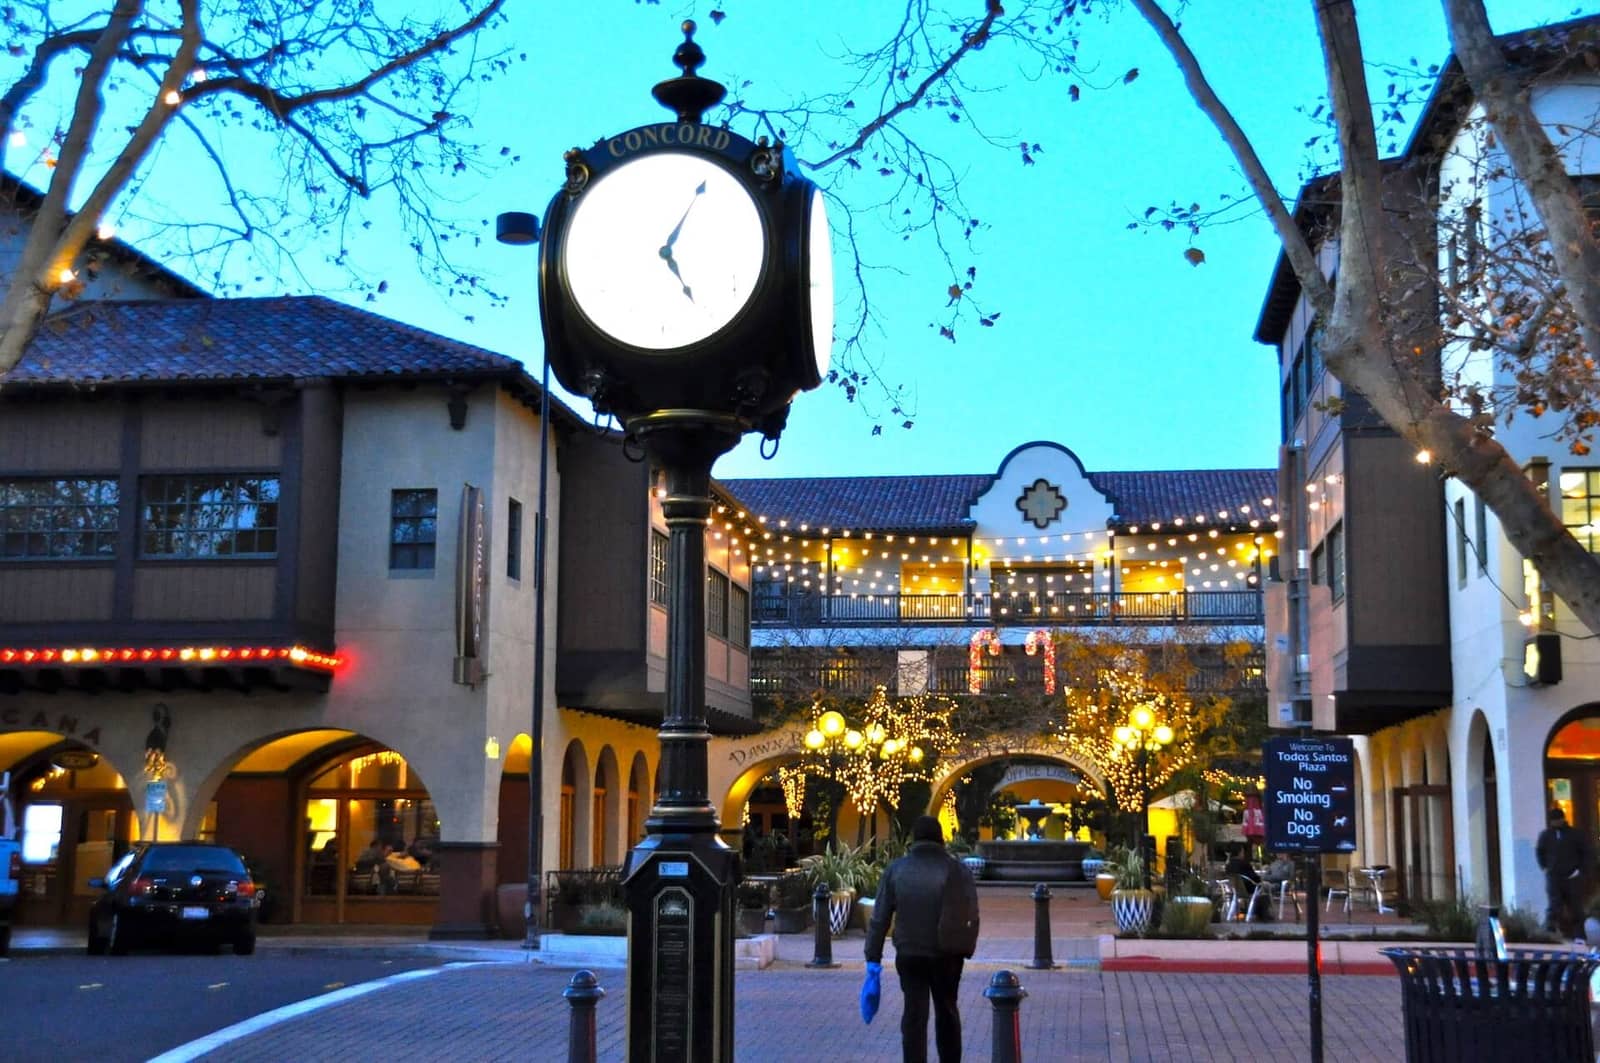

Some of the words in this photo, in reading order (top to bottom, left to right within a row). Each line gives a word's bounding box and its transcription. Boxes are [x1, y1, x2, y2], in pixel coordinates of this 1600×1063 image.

[607, 123, 731, 157] CONCORD
[1289, 743, 1324, 752] Welcome
[1325, 743, 1335, 752] To
[1277, 751, 1309, 762] Todos
[1312, 752, 1348, 763] Santos
[1298, 762, 1327, 772] Plaza
[1293, 777, 1312, 790] No
[1276, 790, 1331, 808] Smoking
[1294, 808, 1313, 821] No
[1287, 821, 1321, 839] Dogs
